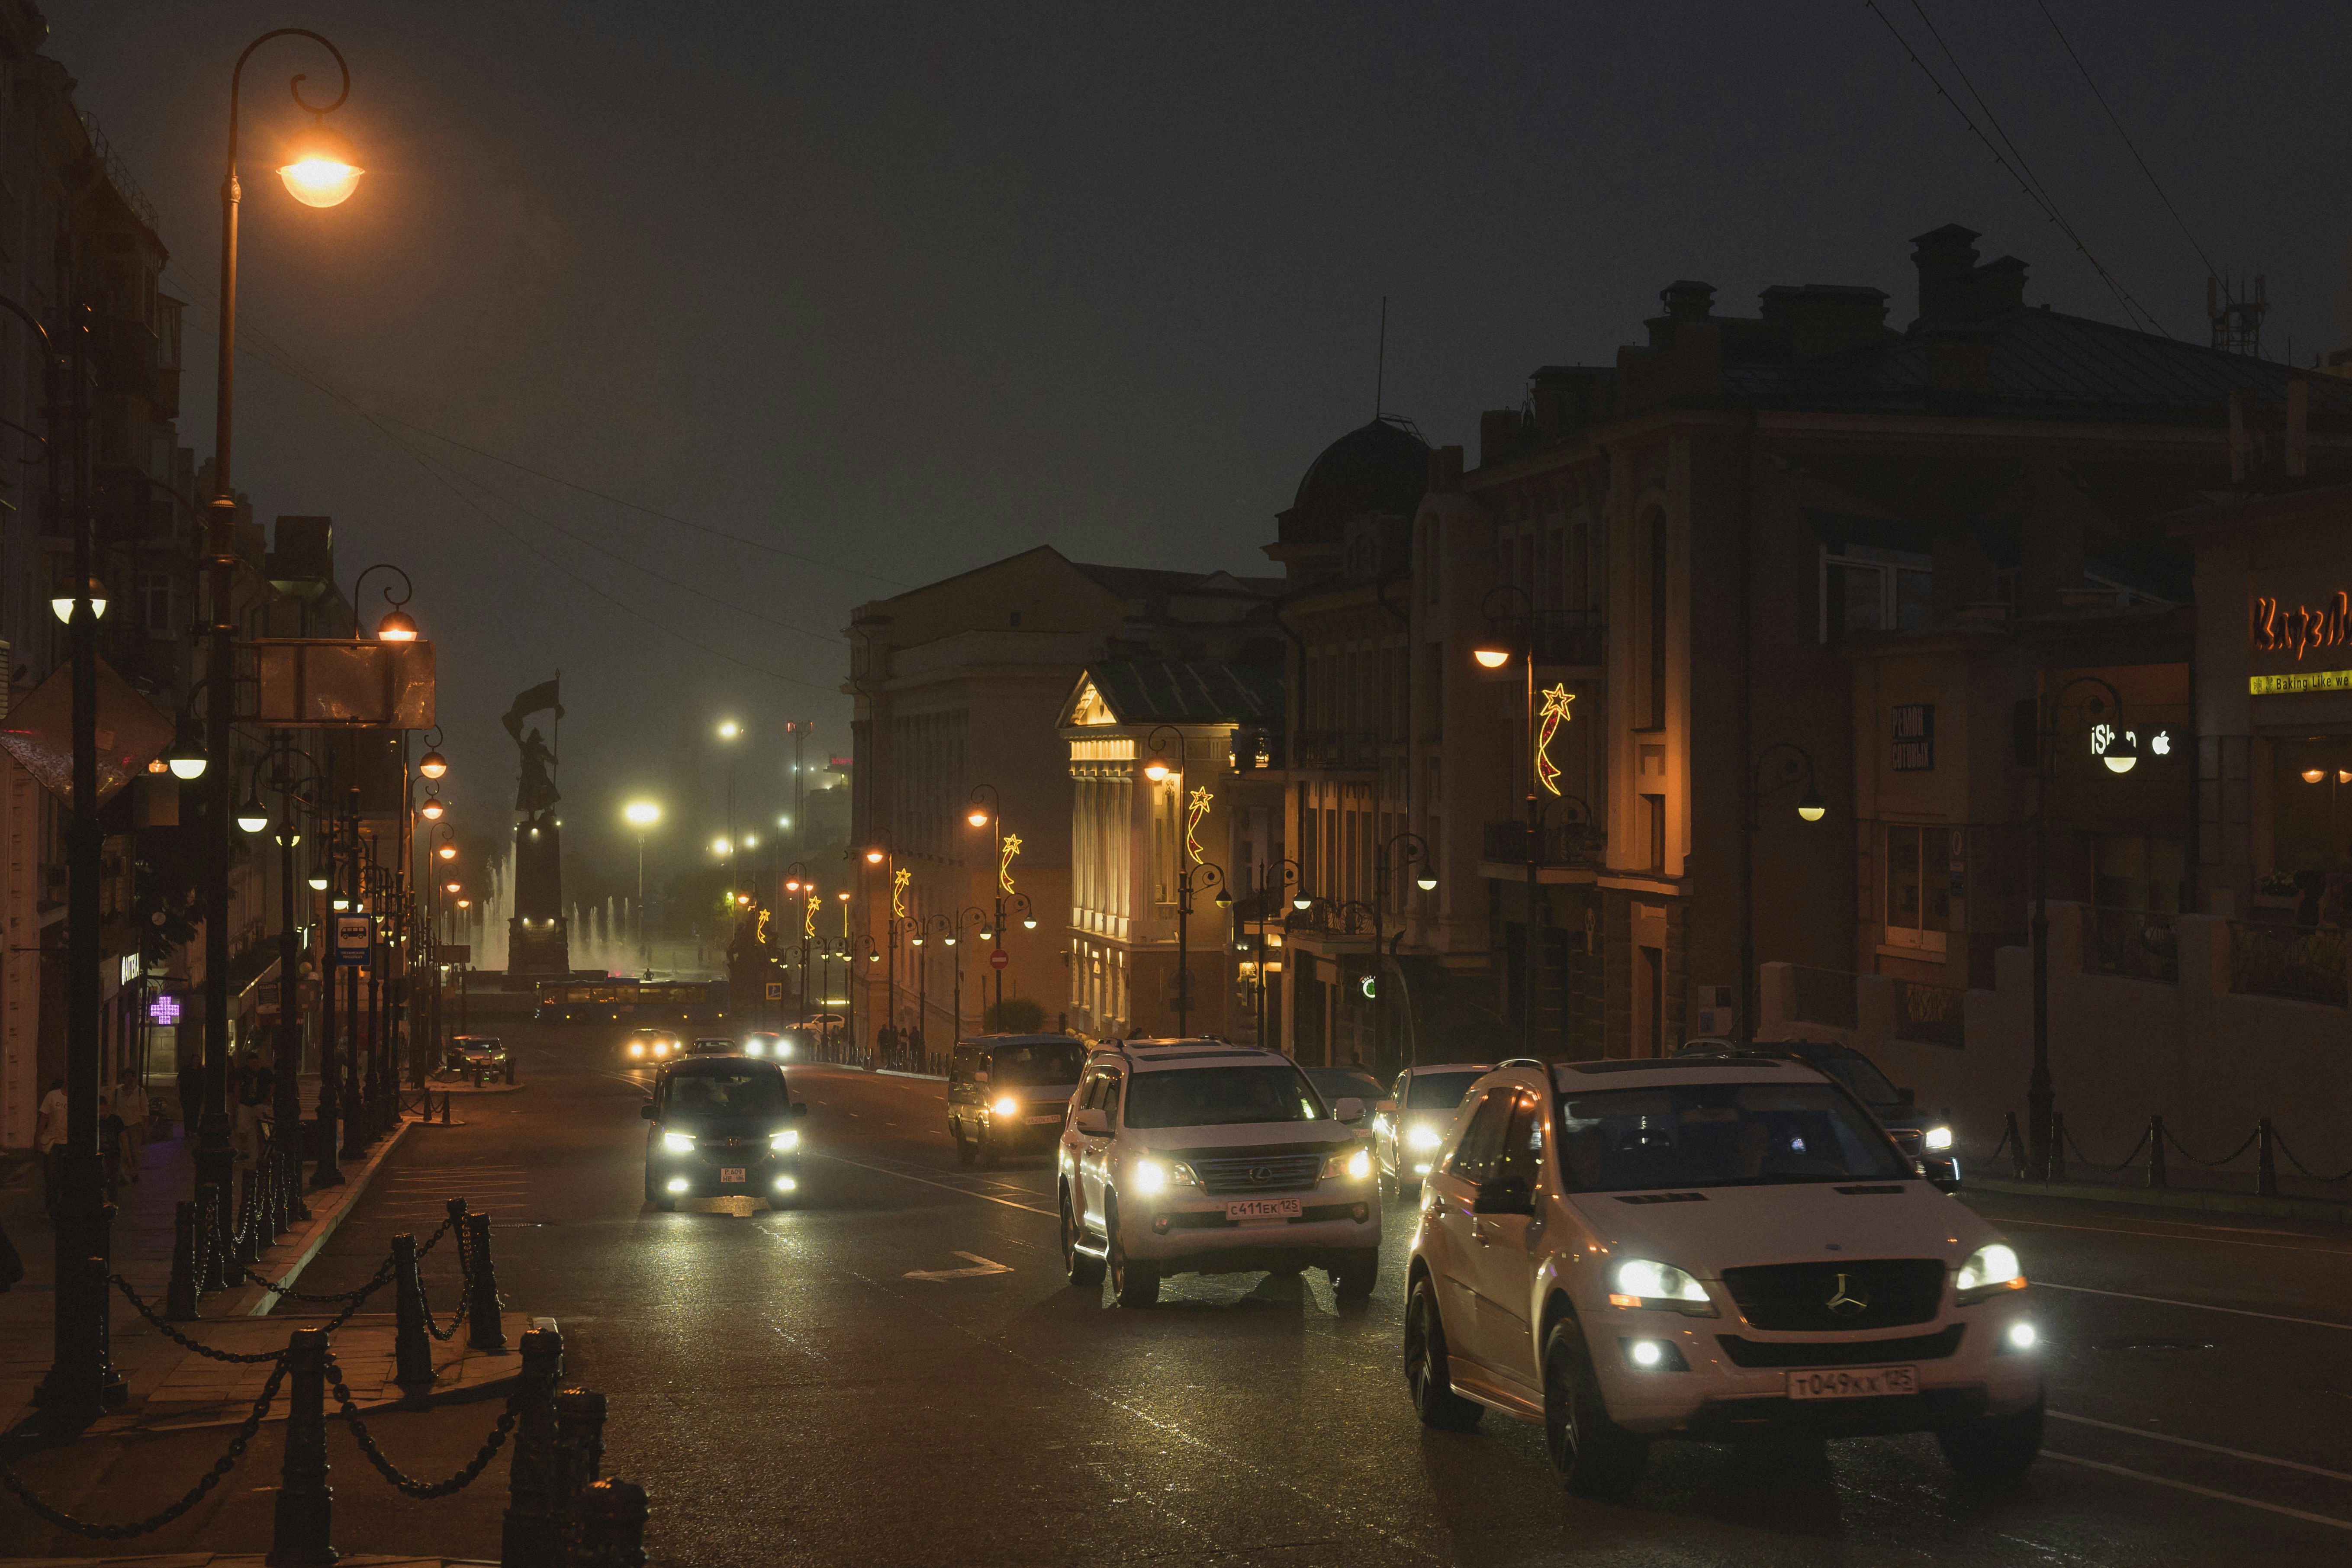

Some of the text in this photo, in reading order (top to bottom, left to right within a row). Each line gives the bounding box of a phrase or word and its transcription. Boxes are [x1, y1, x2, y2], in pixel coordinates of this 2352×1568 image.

[2276, 675, 2349, 691] Baking Like we
[1892, 742, 1929, 770] СОТОВЫХ
[125, 953, 139, 982] АПТЕКА
